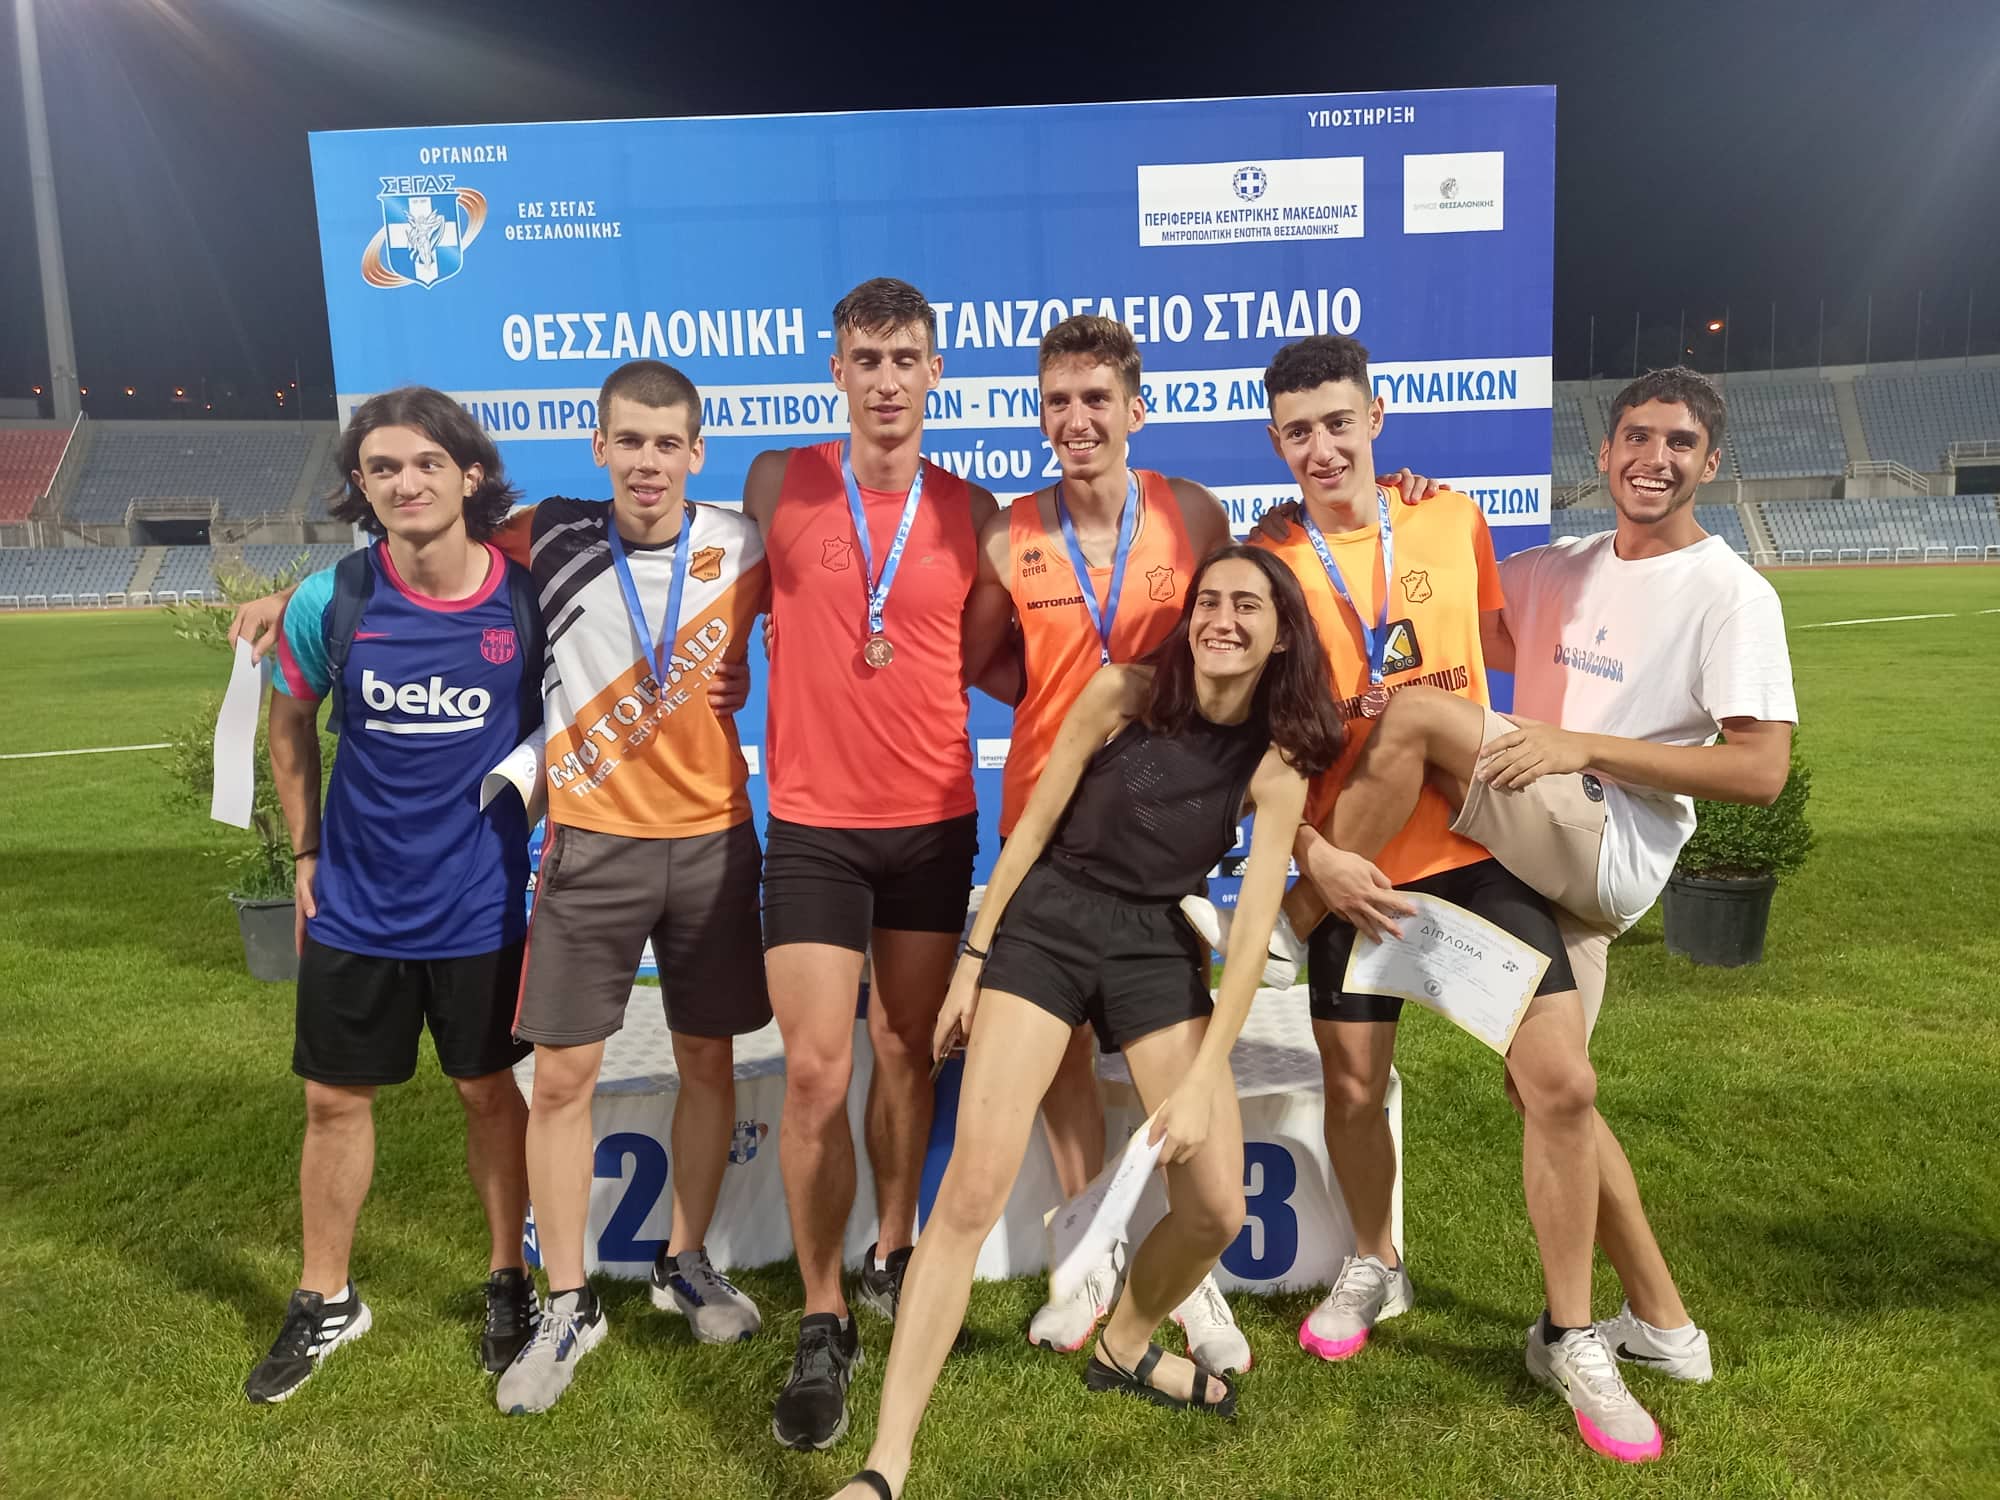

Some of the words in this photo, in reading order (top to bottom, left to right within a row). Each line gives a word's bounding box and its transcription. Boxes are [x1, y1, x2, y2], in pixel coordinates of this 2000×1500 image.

[1307, 106, 1415, 127] ΥΠΟΣΤΗΡΙΞΗ
[419, 145, 508, 165] ΟΡΓΑΝΩΣΗ
[379, 175, 456, 194] ΣΕΓΑΣ
[518, 202, 545, 219] ΕΑΣ
[550, 201, 597, 218] ΣΕΓΑΣ
[1144, 210, 1213, 227] ΠΕΡΙΦΕΡΕΙΑ
[1216, 207, 1279, 224] ΚΕΝΤΡΙΚΗΣ
[1282, 204, 1358, 221] ΜΑΚΕΔΟΝΙΑΣ
[505, 222, 622, 241] ΘΕΣΣΑΛΟΝΙΚΗΣ
[1162, 228, 1232, 241] ΜΗΤΡΟΠΟΛΙΤΙΚΗ
[1234, 226, 1272, 239] ΕΝΟΤΗΤΑ
[1274, 224, 1339, 237] ΘΕΣΣΑΛΟΝΙΚΗΣ
[502, 308, 805, 361] ΘΕΣΣΑΛΟΝΙΚΗ
[1202, 287, 1361, 341] ΣΤΑΔΙΟ
[739, 394, 839, 426] ΣΤΙΒΟΥ
[1373, 370, 1517, 403] ΓΥΝΑΙΚΩΝ
[1022, 563, 1047, 578] errea
[362, 669, 491, 718] beko
[1420, 925, 1483, 961] ΔΙΠΛΩΜΑ
[593, 1132, 670, 1262] 2
[1219, 1141, 1298, 1280] 3
